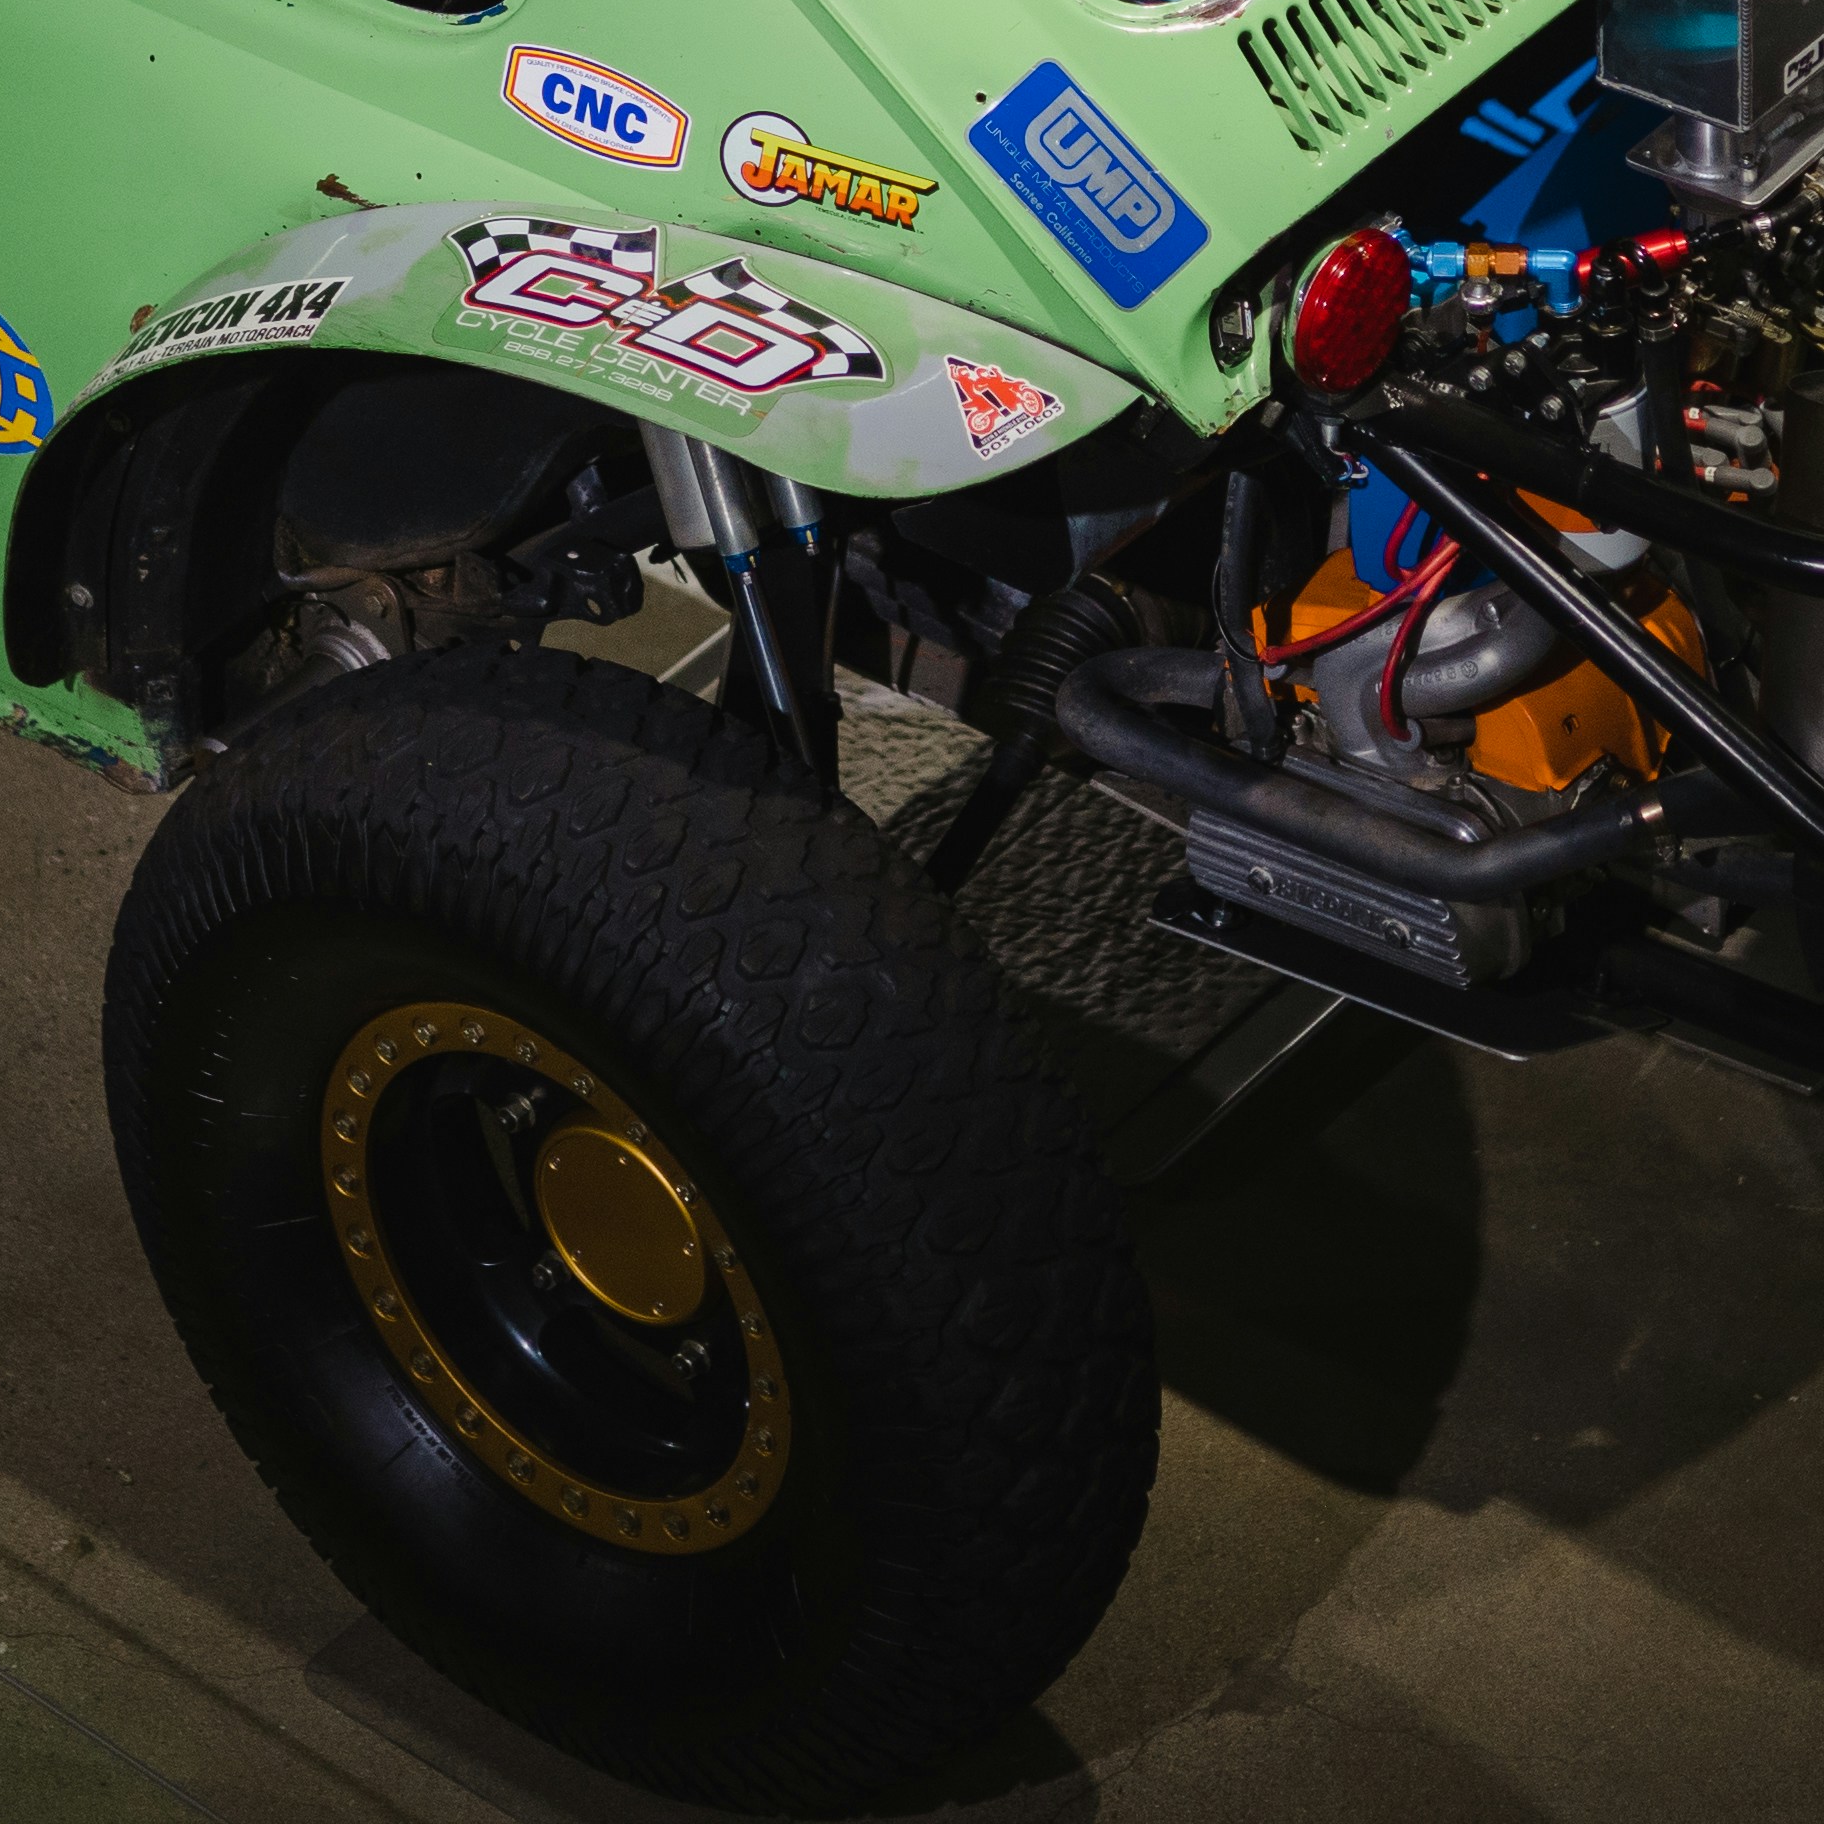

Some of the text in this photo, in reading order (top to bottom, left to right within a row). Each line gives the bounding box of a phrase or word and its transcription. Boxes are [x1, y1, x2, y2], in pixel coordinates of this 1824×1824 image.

[526, 58, 673, 124] QUALITY PEDALS AND BRAKE COMPONENTS
[541, 72, 648, 145] CNC
[546, 111, 561, 126] SAN
[588, 133, 635, 153] CALIFORNIA
[740, 126, 940, 233] JAMAR
[1042, 111, 1160, 229] UMP
[984, 119, 1146, 295] UNIQUE METAL PRODUCTS
[1046, 211, 1094, 266] California
[254, 279, 346, 324] 4X4
[133, 335, 217, 370] ALL-TERRAIN
[216, 324, 316, 347] MOTORCOACH
[455, 309, 753, 417] CYCLE CENTER
[980, 434, 1011, 458] DOS
[1015, 401, 1062, 436] LOCOS
